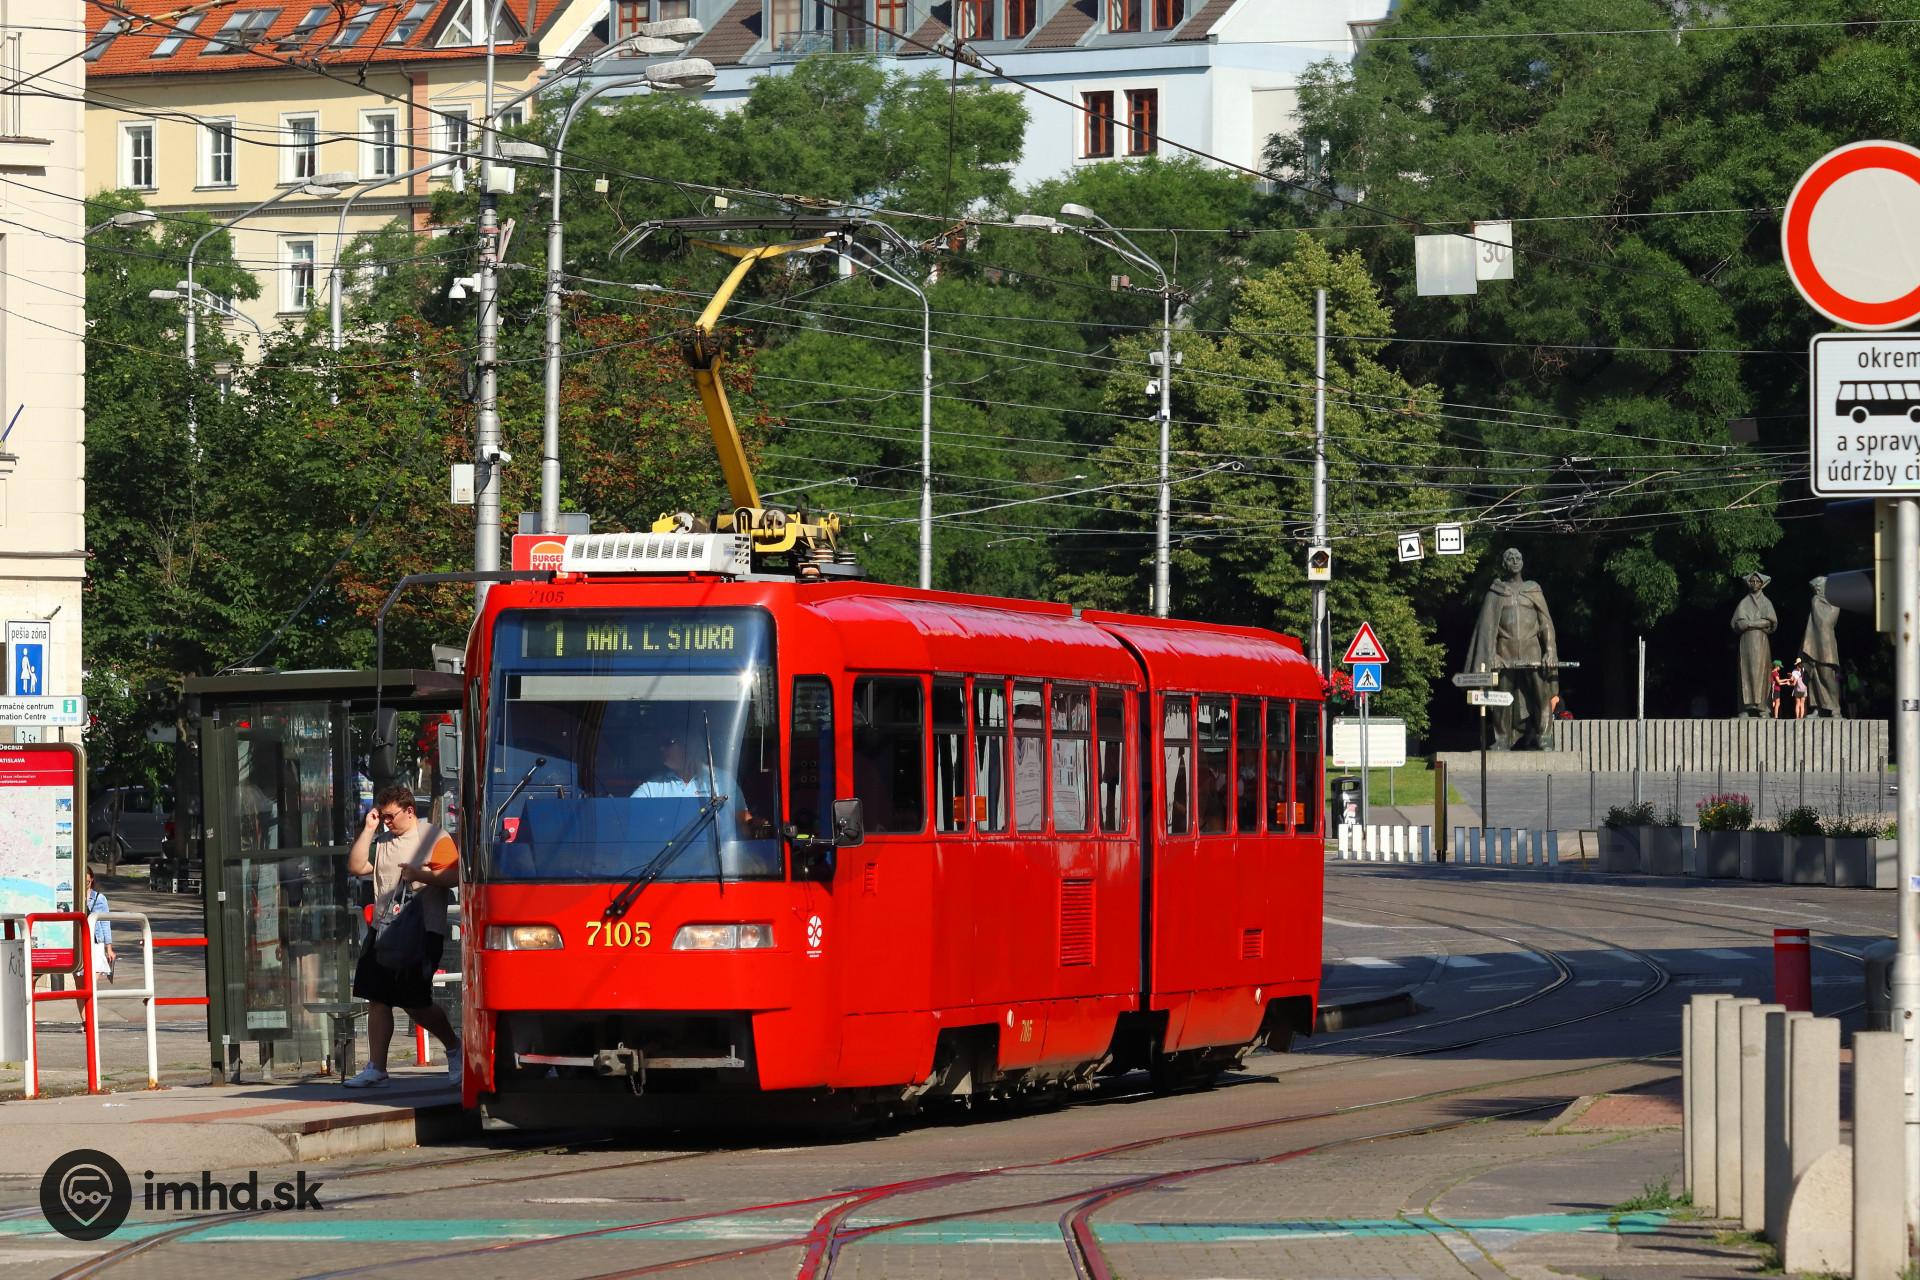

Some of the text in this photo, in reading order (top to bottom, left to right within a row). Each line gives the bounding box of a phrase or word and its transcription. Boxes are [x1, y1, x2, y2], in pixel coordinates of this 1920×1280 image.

[1481, 240, 1506, 263] 30
[1858, 347, 1920, 368] okrem
[1837, 435, 1847, 451] a
[1828, 459, 1897, 486] údržby
[11, 627, 47, 641] pešia zóna
[585, 921, 651, 947] 7105
